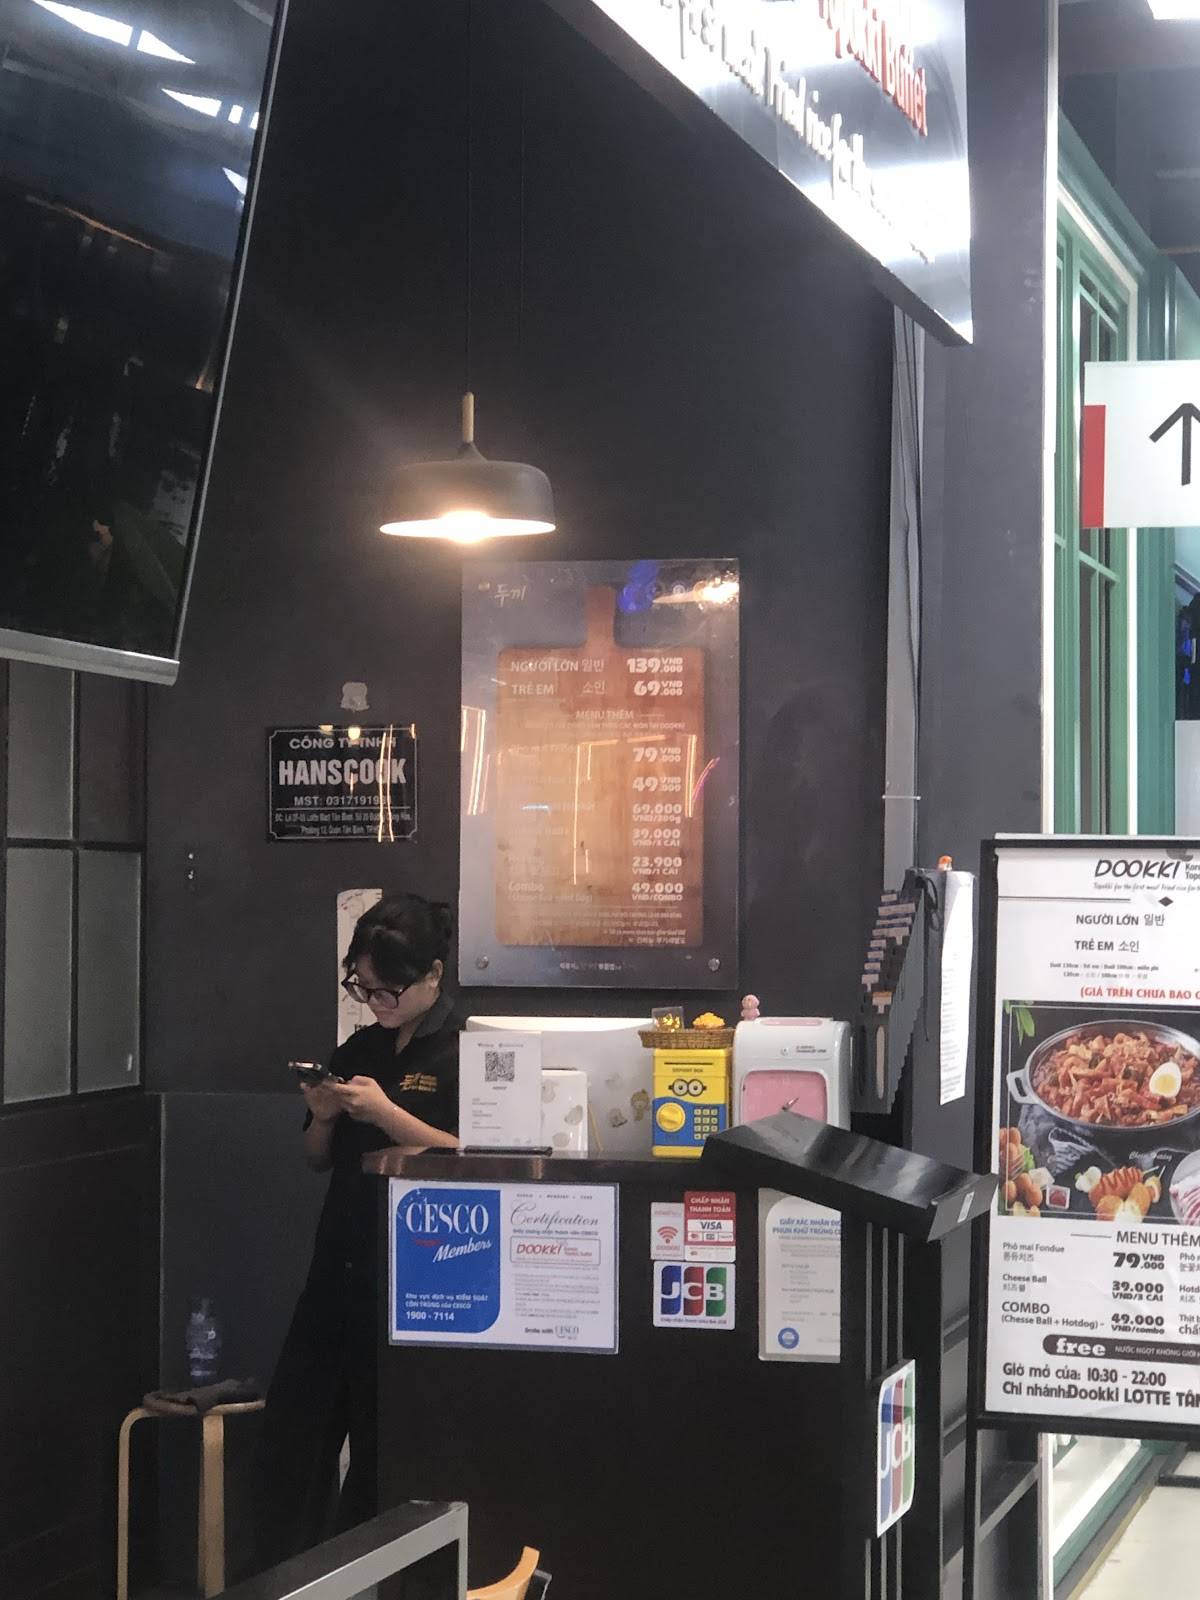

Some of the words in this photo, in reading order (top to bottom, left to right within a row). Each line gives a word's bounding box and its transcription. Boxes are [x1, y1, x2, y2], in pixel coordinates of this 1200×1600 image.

[627, 657, 660, 673] 139
[536, 684, 554, 695] EM
[582, 680, 606, 695] 소인
[634, 681, 661, 696] 69
[289, 735, 335, 749] CÔNG
[633, 747, 658, 762] 79
[278, 758, 407, 785] HANSCOOK
[632, 776, 659, 791] 49
[632, 803, 683, 814] 69.000
[632, 828, 681, 839] 39.000
[632, 856, 683, 867] 23.900
[1094, 859, 1181, 879] DOOKKI
[631, 882, 684, 894] 49.000
[1076, 913, 1113, 925] NGƯỜI
[1116, 913, 1139, 926] LỚN
[1143, 913, 1166, 926] 일반
[1075, 938, 1094, 950] TRẺ
[1097, 941, 1114, 951] EM
[1118, 940, 1140, 953] 소인
[405, 1202, 489, 1235] CESCO
[510, 1202, 600, 1232] Certification
[700, 1221, 722, 1230] VISA
[1116, 1232, 1159, 1245] MENU
[432, 1239, 493, 1263] Members
[516, 1243, 562, 1255] DOOKKI
[1019, 1243, 1034, 1251] mai
[1035, 1243, 1065, 1252] Fondue
[1113, 1252, 1141, 1268] 79
[1032, 1275, 1047, 1283] Ball
[661, 1281, 725, 1300] JCB
[1112, 1280, 1164, 1293] 39.000
[1001, 1301, 1050, 1314] COMBO
[406, 1311, 427, 1321] 1900
[433, 1311, 455, 1321] 7114
[1036, 1316, 1052, 1325] Ball
[1062, 1318, 1099, 1329] Hotdog)
[1111, 1313, 1165, 1326] 49.000
[1055, 1338, 1106, 1356] free
[1088, 1368, 1118, 1383] 10:30
[1131, 1370, 1167, 1386] 22:00
[1124, 1389, 1171, 1406] LOTTE
[880, 1415, 912, 1479] JCB
